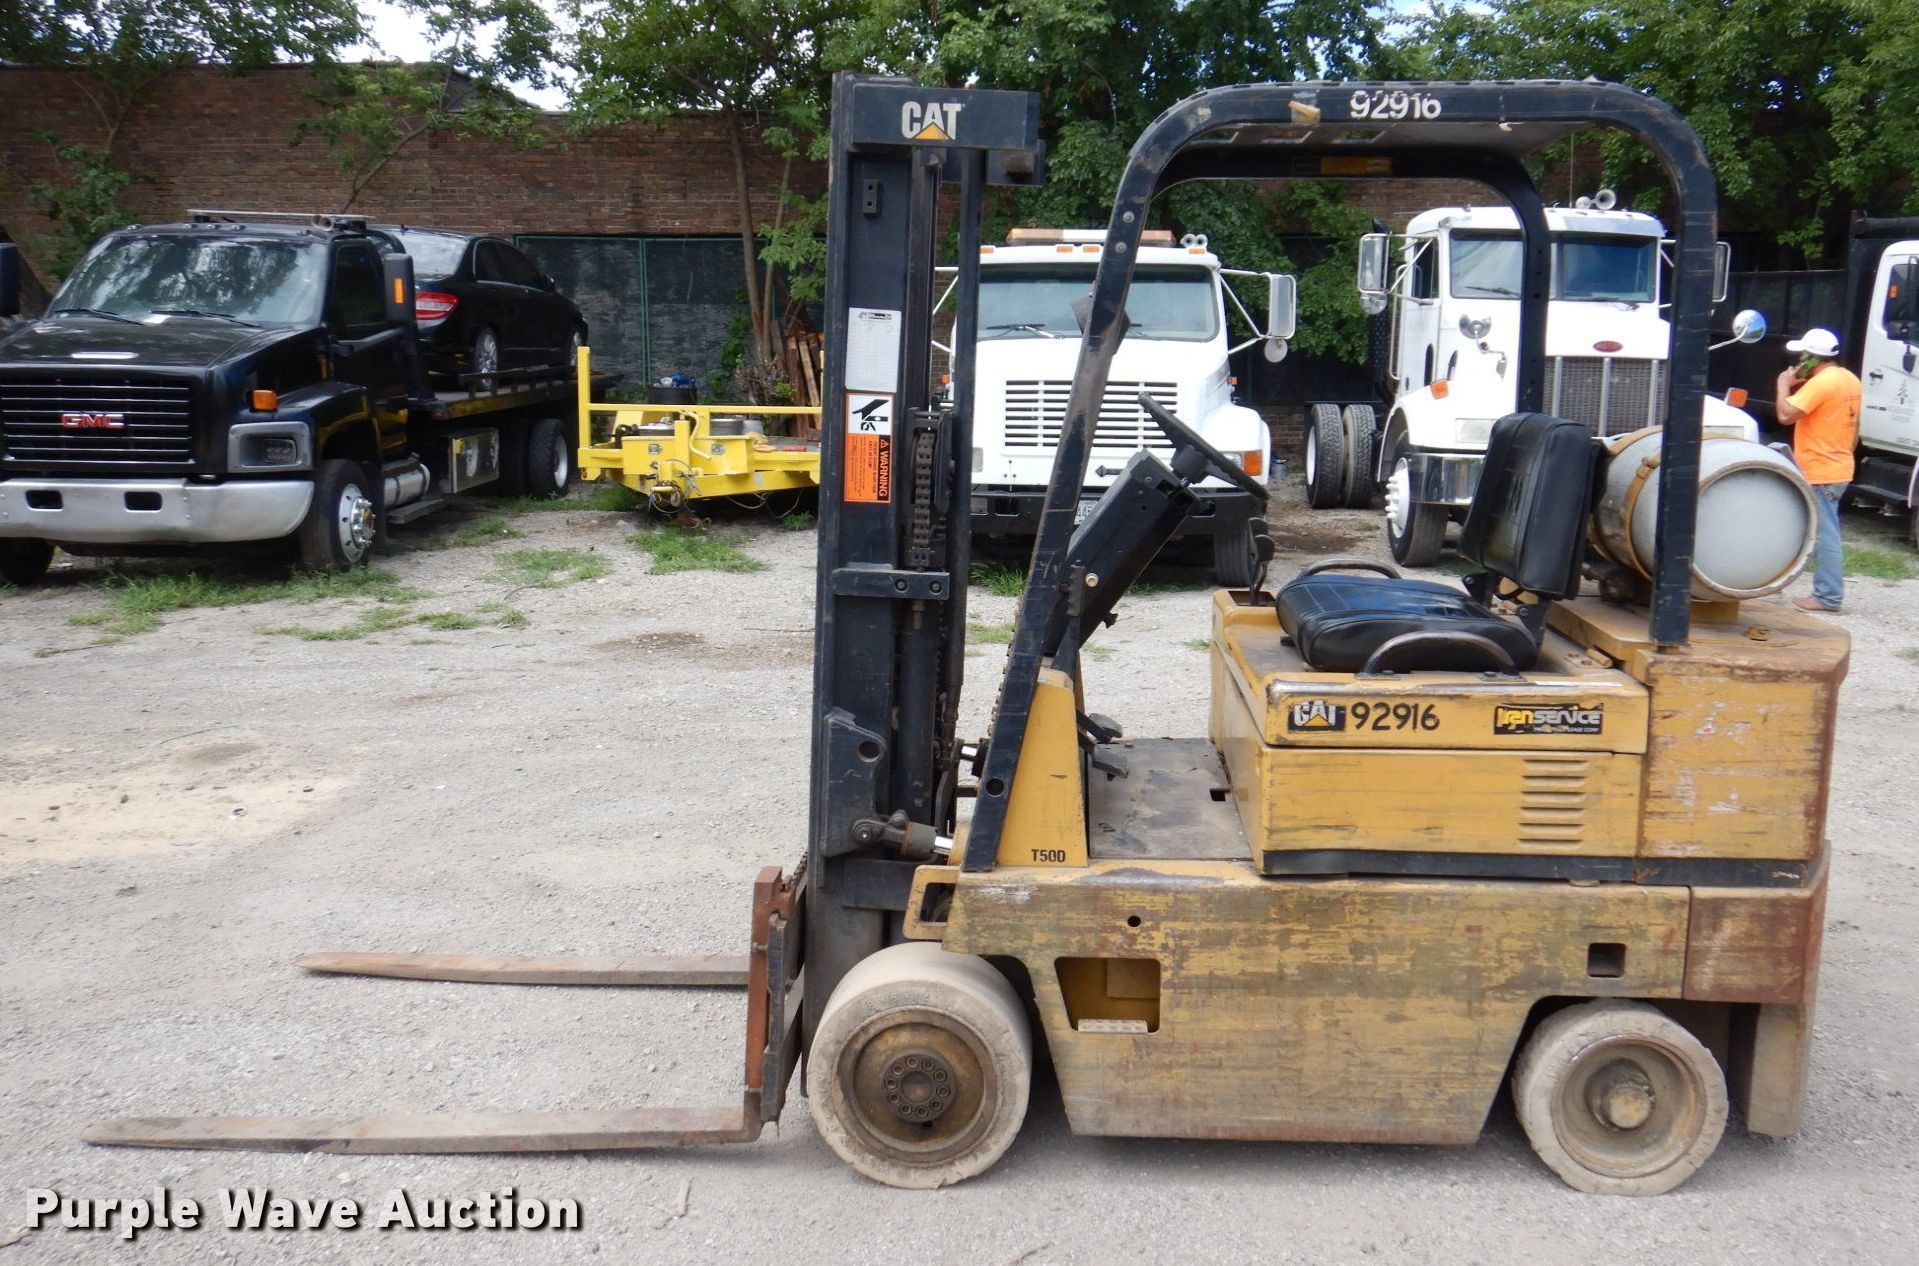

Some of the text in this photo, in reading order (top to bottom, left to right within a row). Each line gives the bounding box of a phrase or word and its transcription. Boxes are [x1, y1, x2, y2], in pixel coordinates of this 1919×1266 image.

[1351, 90, 1442, 119] 92916
[902, 101, 963, 140] CAT
[61, 413, 125, 429] GMC
[878, 452, 890, 497] WARNING
[1294, 700, 1441, 731] CAT 92916
